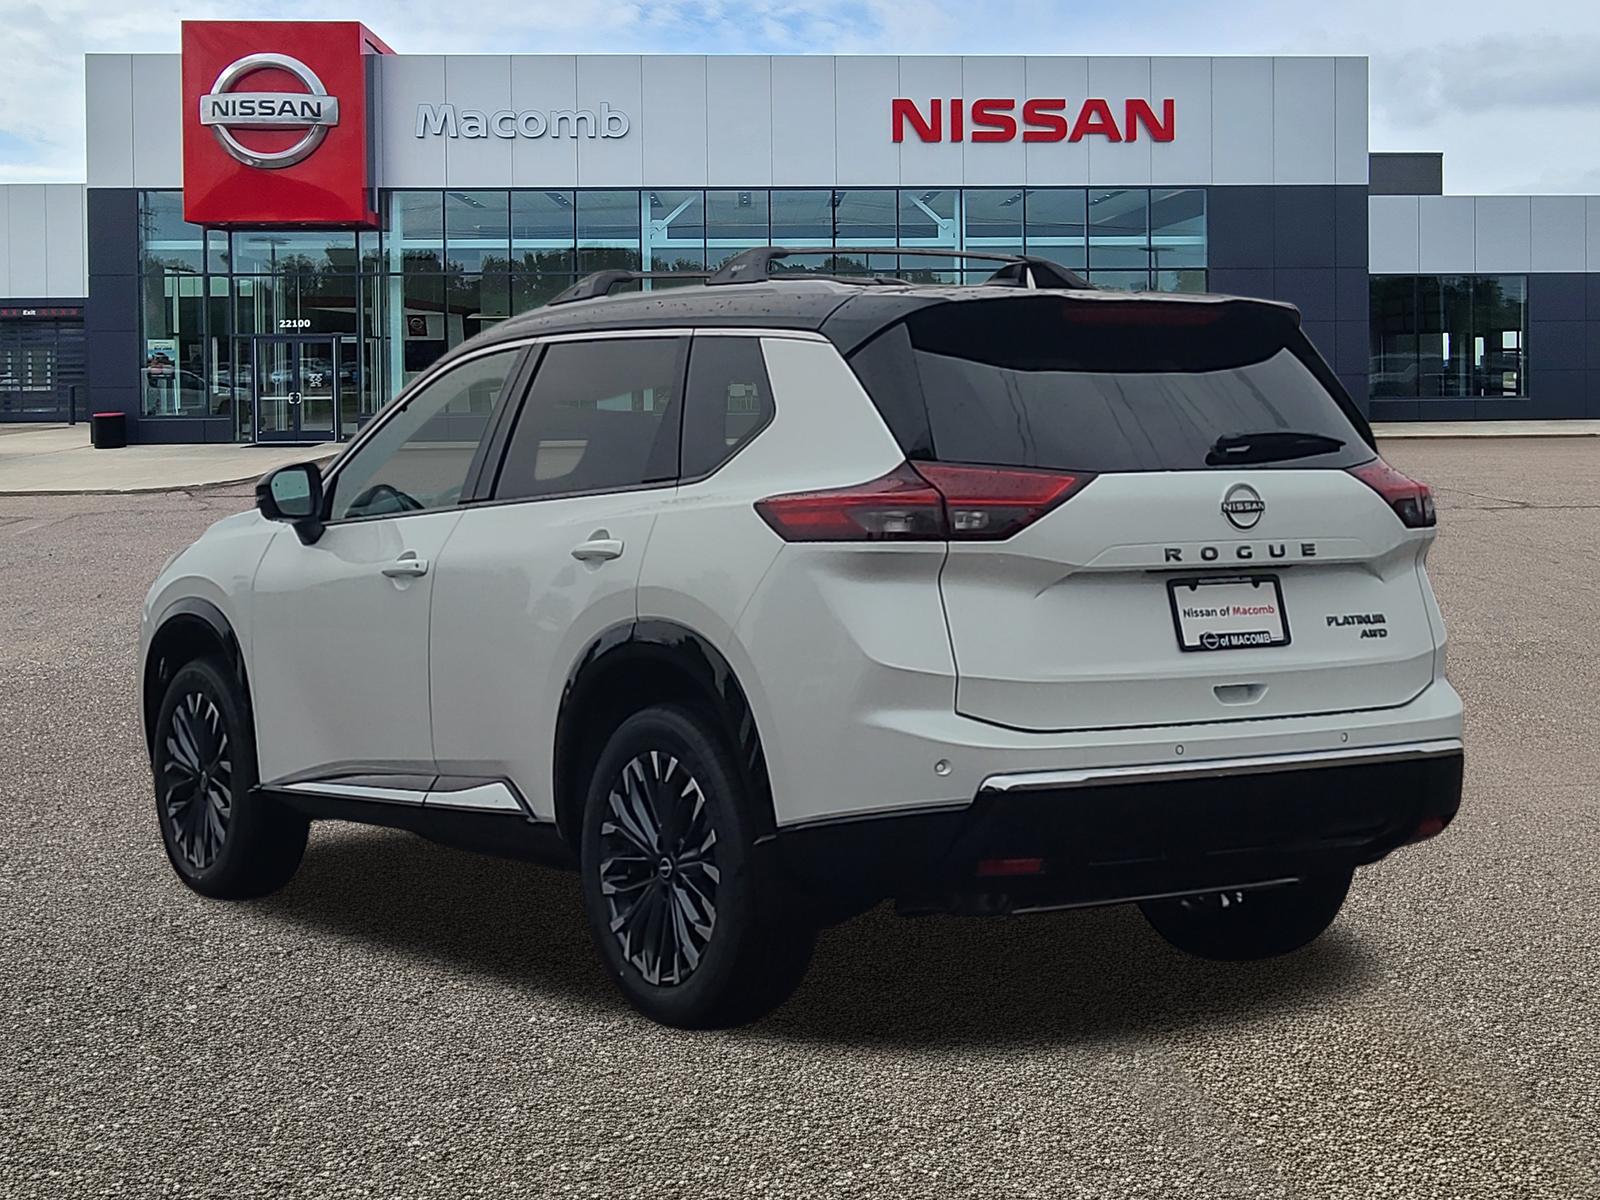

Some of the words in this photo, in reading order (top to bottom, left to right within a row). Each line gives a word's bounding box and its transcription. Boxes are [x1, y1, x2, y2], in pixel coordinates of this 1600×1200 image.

[211, 100, 322, 118] NISSAN
[415, 101, 630, 139] Macomb
[891, 98, 1175, 143] NISSAN
[279, 319, 311, 328] 22100
[1222, 501, 1265, 512] NISSAN
[1164, 543, 1317, 562] ROGUE
[1183, 608, 1218, 618] Nissan
[1219, 606, 1230, 617] of
[1232, 605, 1275, 616] Macomb
[1326, 614, 1386, 627] PLATINUM
[1220, 635, 1229, 646] of
[1230, 633, 1271, 645] MACOMB
[1360, 628, 1388, 639] AWD
